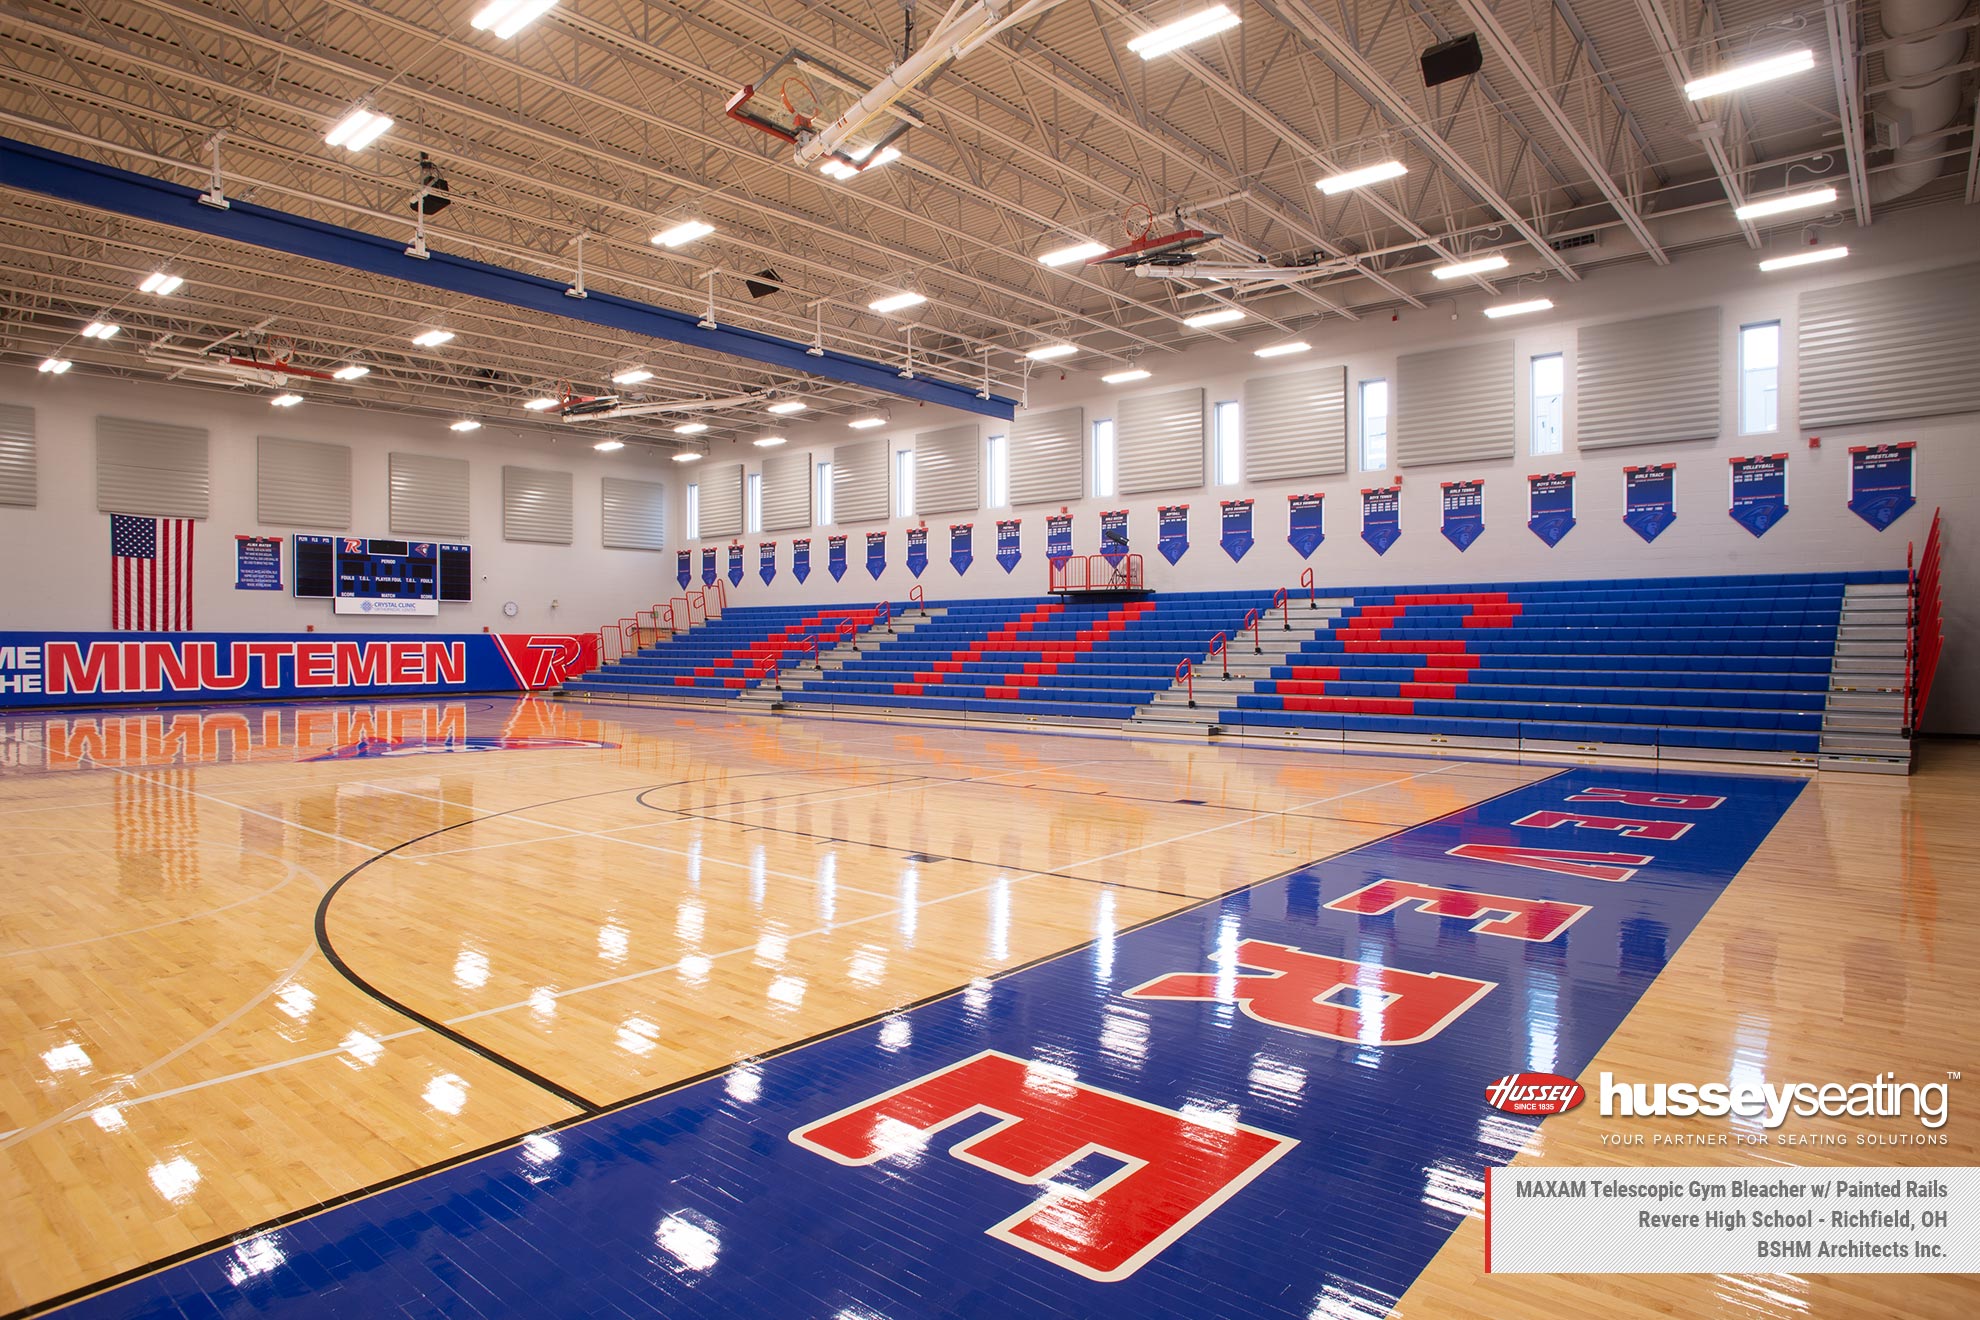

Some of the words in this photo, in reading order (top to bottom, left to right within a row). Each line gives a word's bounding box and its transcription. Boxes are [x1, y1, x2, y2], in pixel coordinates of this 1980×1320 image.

[1865, 452, 1899, 460] WRESTLING
[1742, 463, 1775, 471] VOLLEYBALL
[343, 537, 362, 554] R
[45, 641, 466, 695] MINUTEMEN
[788, 787, 1728, 1283] REVERE
